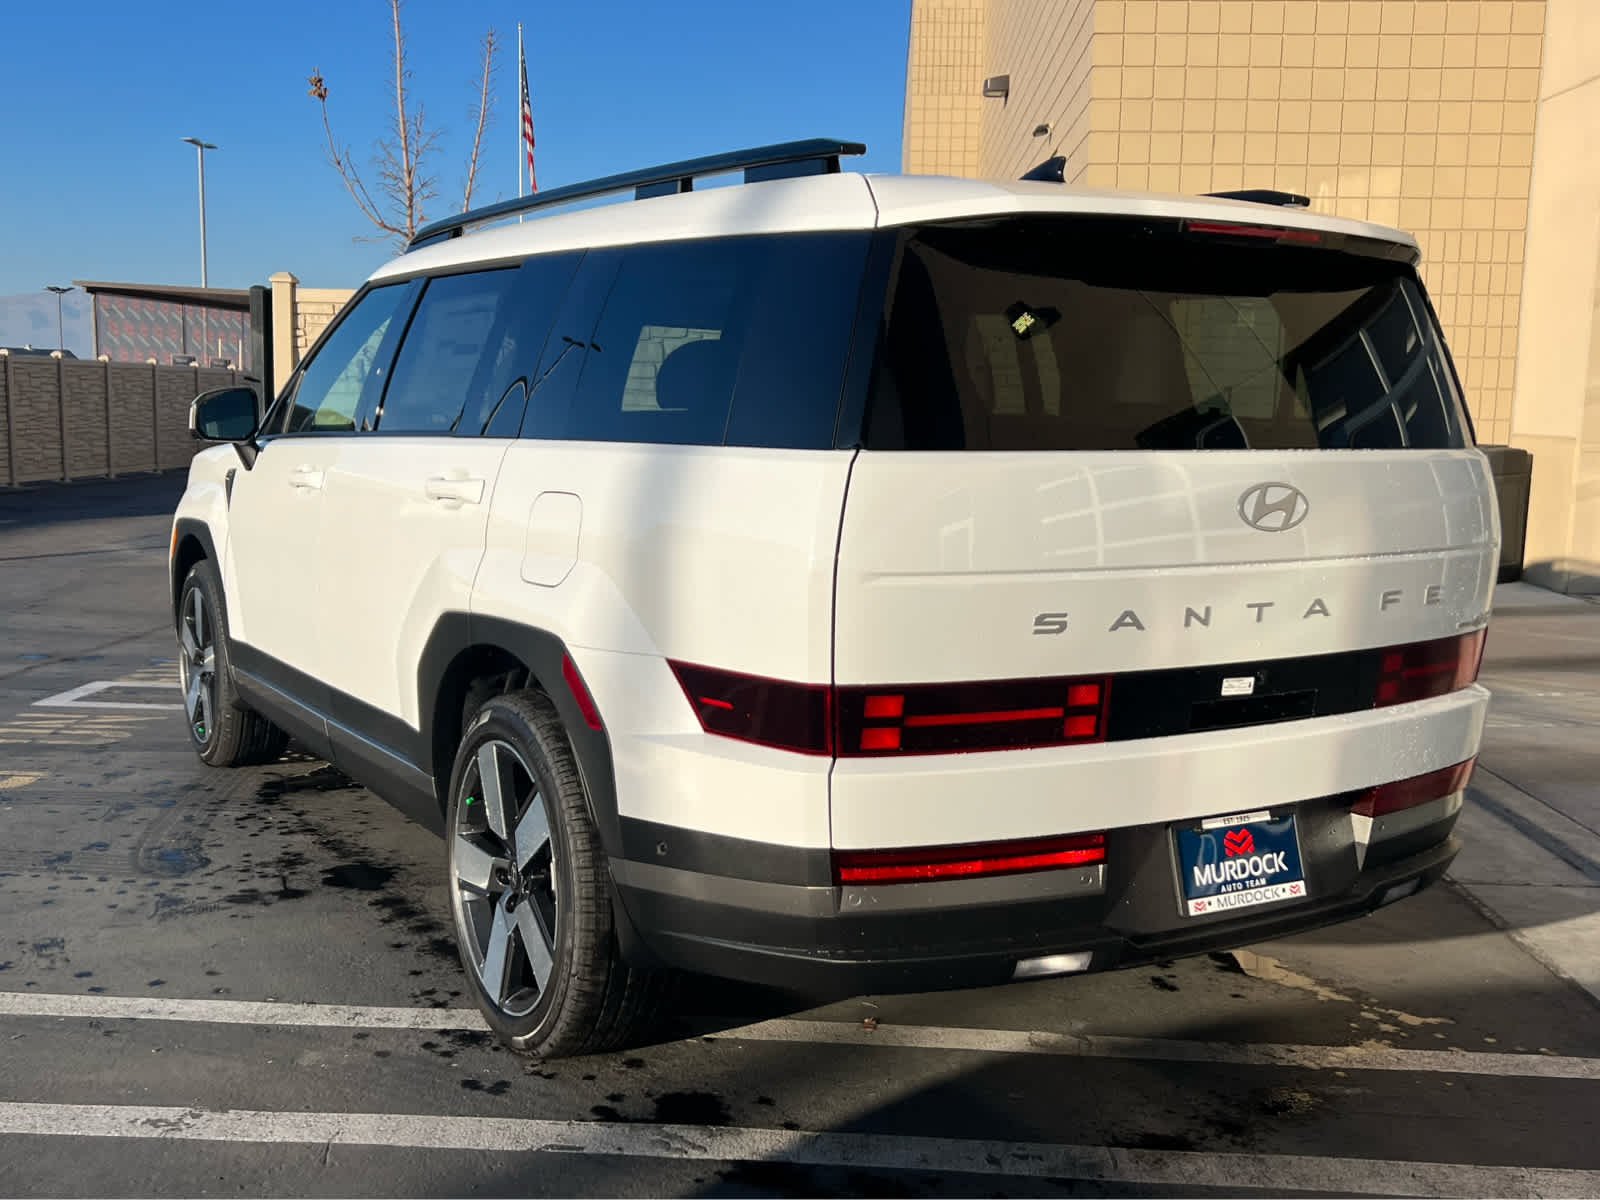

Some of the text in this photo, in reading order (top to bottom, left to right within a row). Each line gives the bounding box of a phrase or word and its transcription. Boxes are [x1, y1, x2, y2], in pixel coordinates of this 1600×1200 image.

[1032, 583, 1441, 636] SANTA FE
[1193, 851, 1288, 886] MURDOCK
[1216, 887, 1280, 909] MURDOCK
[1221, 878, 1266, 893] AUTO TEAM
